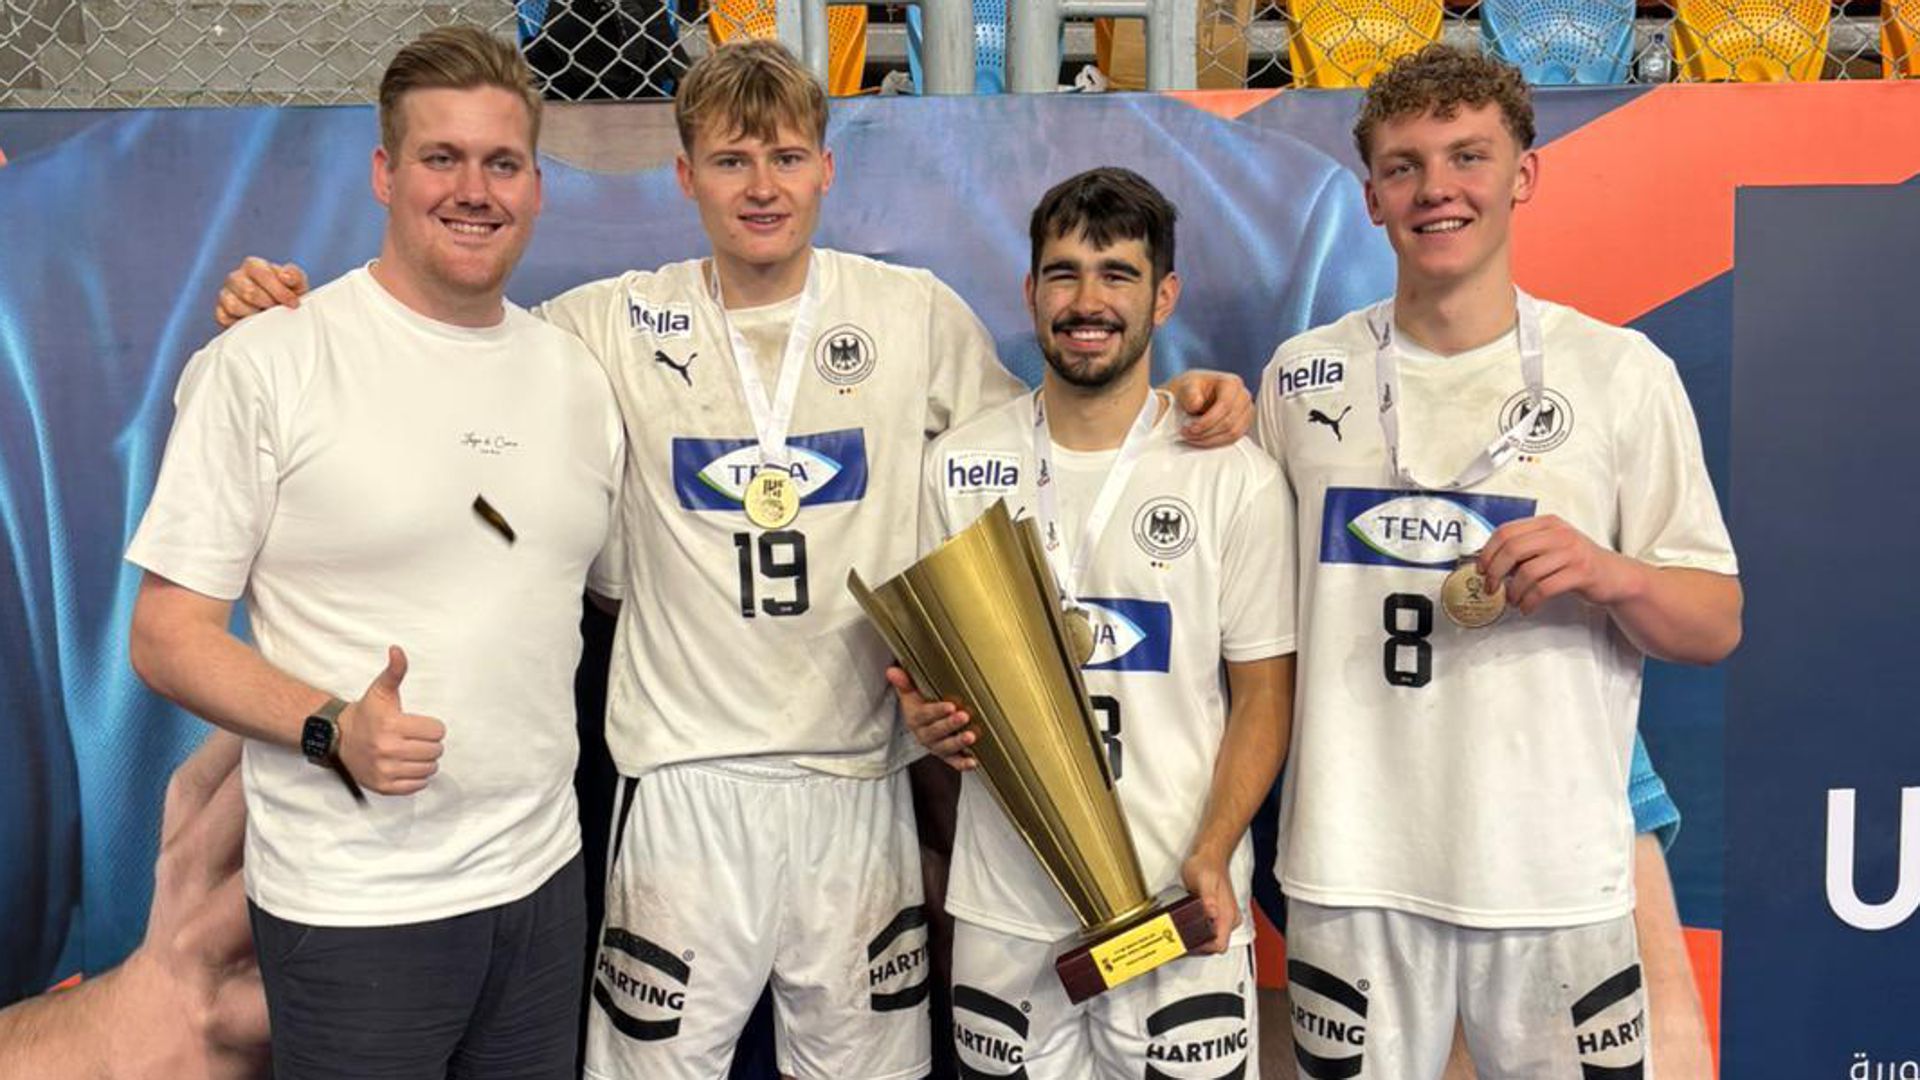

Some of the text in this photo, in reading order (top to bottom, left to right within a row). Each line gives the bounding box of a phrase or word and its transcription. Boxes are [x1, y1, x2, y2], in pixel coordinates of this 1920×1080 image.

[627, 296, 690, 334] hella
[1278, 357, 1344, 397] hella
[947, 457, 1019, 489] hella
[1378, 515, 1463, 544] TENA
[733, 530, 810, 618] 19
[1383, 592, 1433, 689] 8
[598, 953, 686, 1012] HARTING
[1146, 1027, 1248, 1063] HARTING
